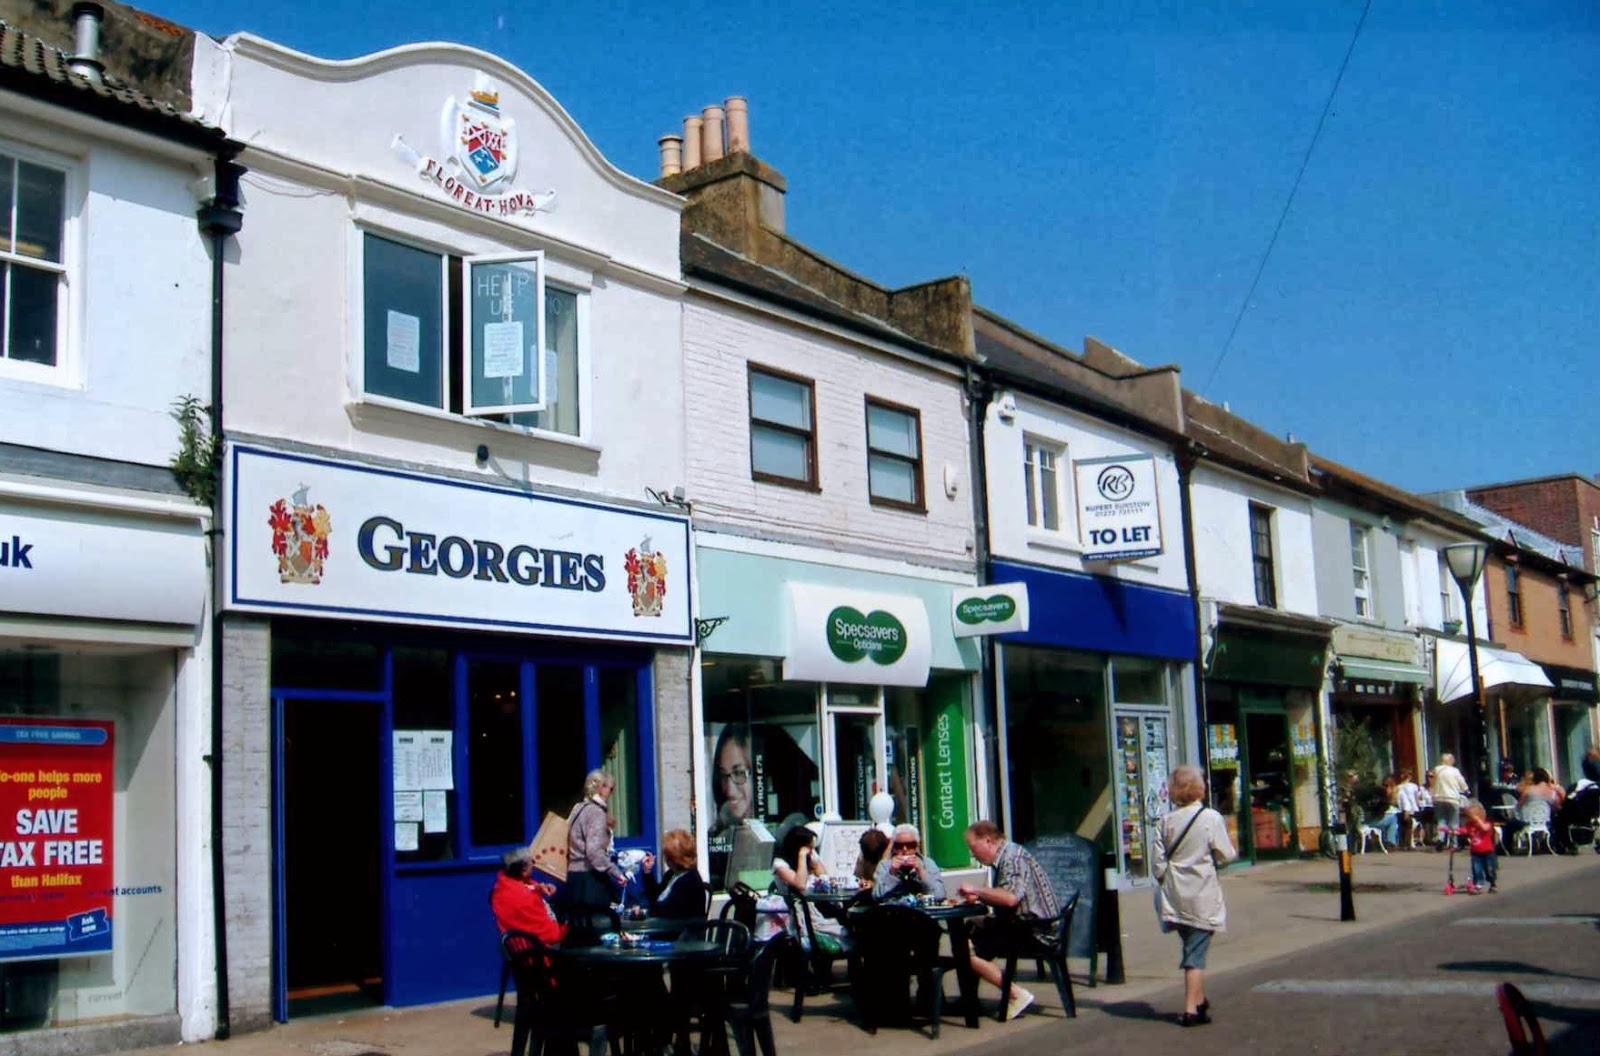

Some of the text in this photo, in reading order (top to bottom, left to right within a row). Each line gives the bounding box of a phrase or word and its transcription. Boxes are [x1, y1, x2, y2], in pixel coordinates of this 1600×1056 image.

[426, 159, 534, 214] FLOREAT HOVA
[1089, 526, 1151, 545] TO LET
[357, 516, 606, 593] GEORGIES
[835, 618, 899, 641] Specsavers
[0, 769, 102, 785] o-one helps more
[937, 714, 954, 829] Contact Lenses
[28, 785, 68, 801] people
[16, 809, 78, 835] SAVE
[44, 839, 103, 866] FREE
[11, 874, 82, 888] than Halifax
[121, 885, 162, 896] accounts
[81, 916, 95, 925] Ask
